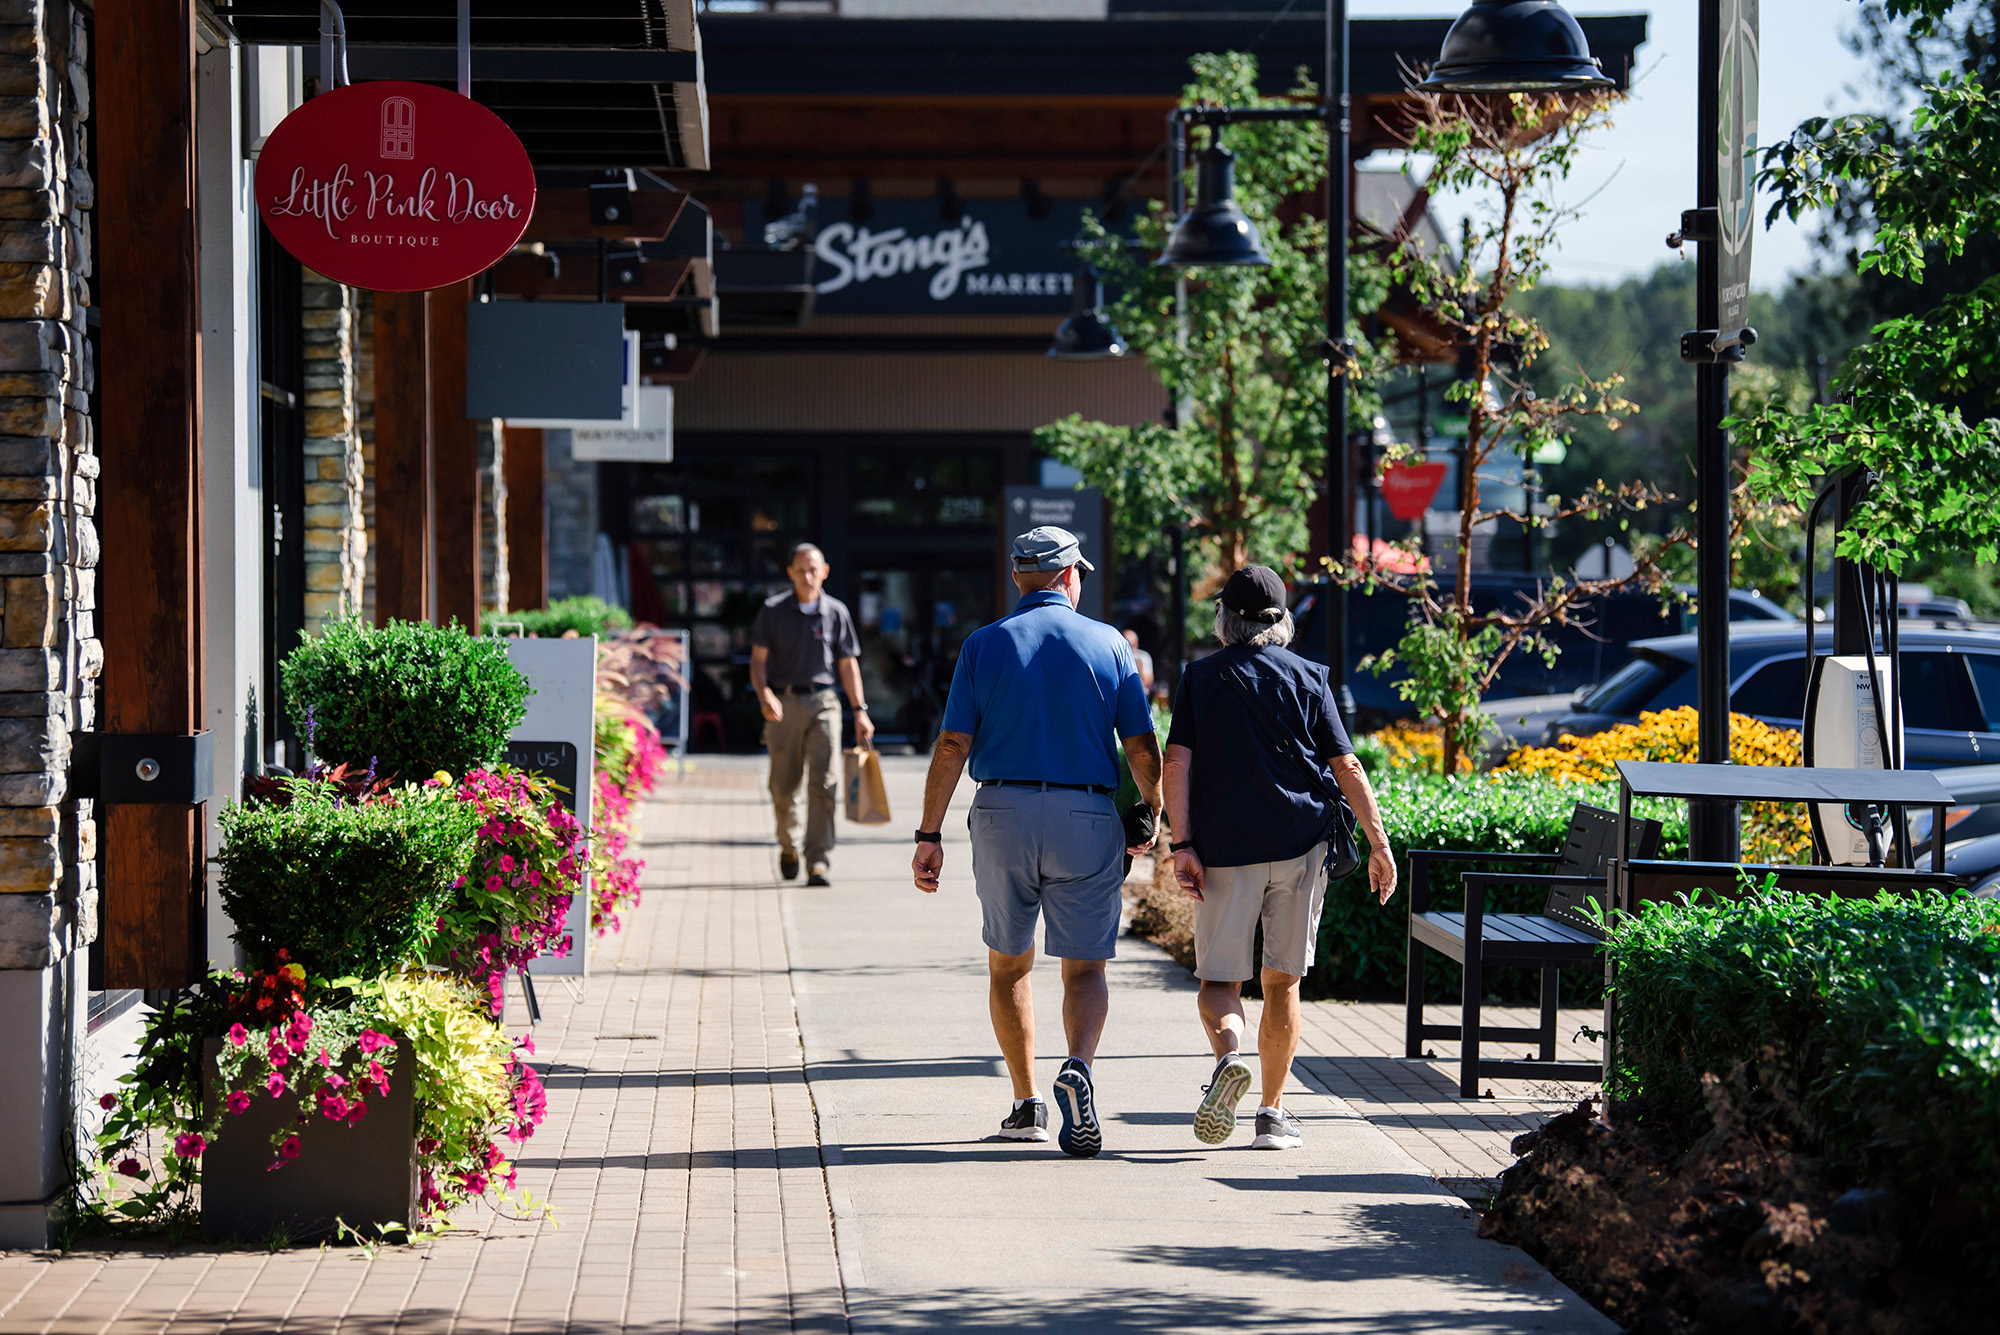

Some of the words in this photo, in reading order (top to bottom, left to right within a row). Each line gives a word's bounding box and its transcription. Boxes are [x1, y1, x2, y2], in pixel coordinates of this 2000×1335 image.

[270, 164, 357, 239] Little
[364, 167, 441, 222] Pink
[445, 172, 521, 224] Door
[350, 234, 440, 248] BOUTIQUE
[814, 214, 990, 300] Stong's
[965, 273, 1074, 296] MARKET
